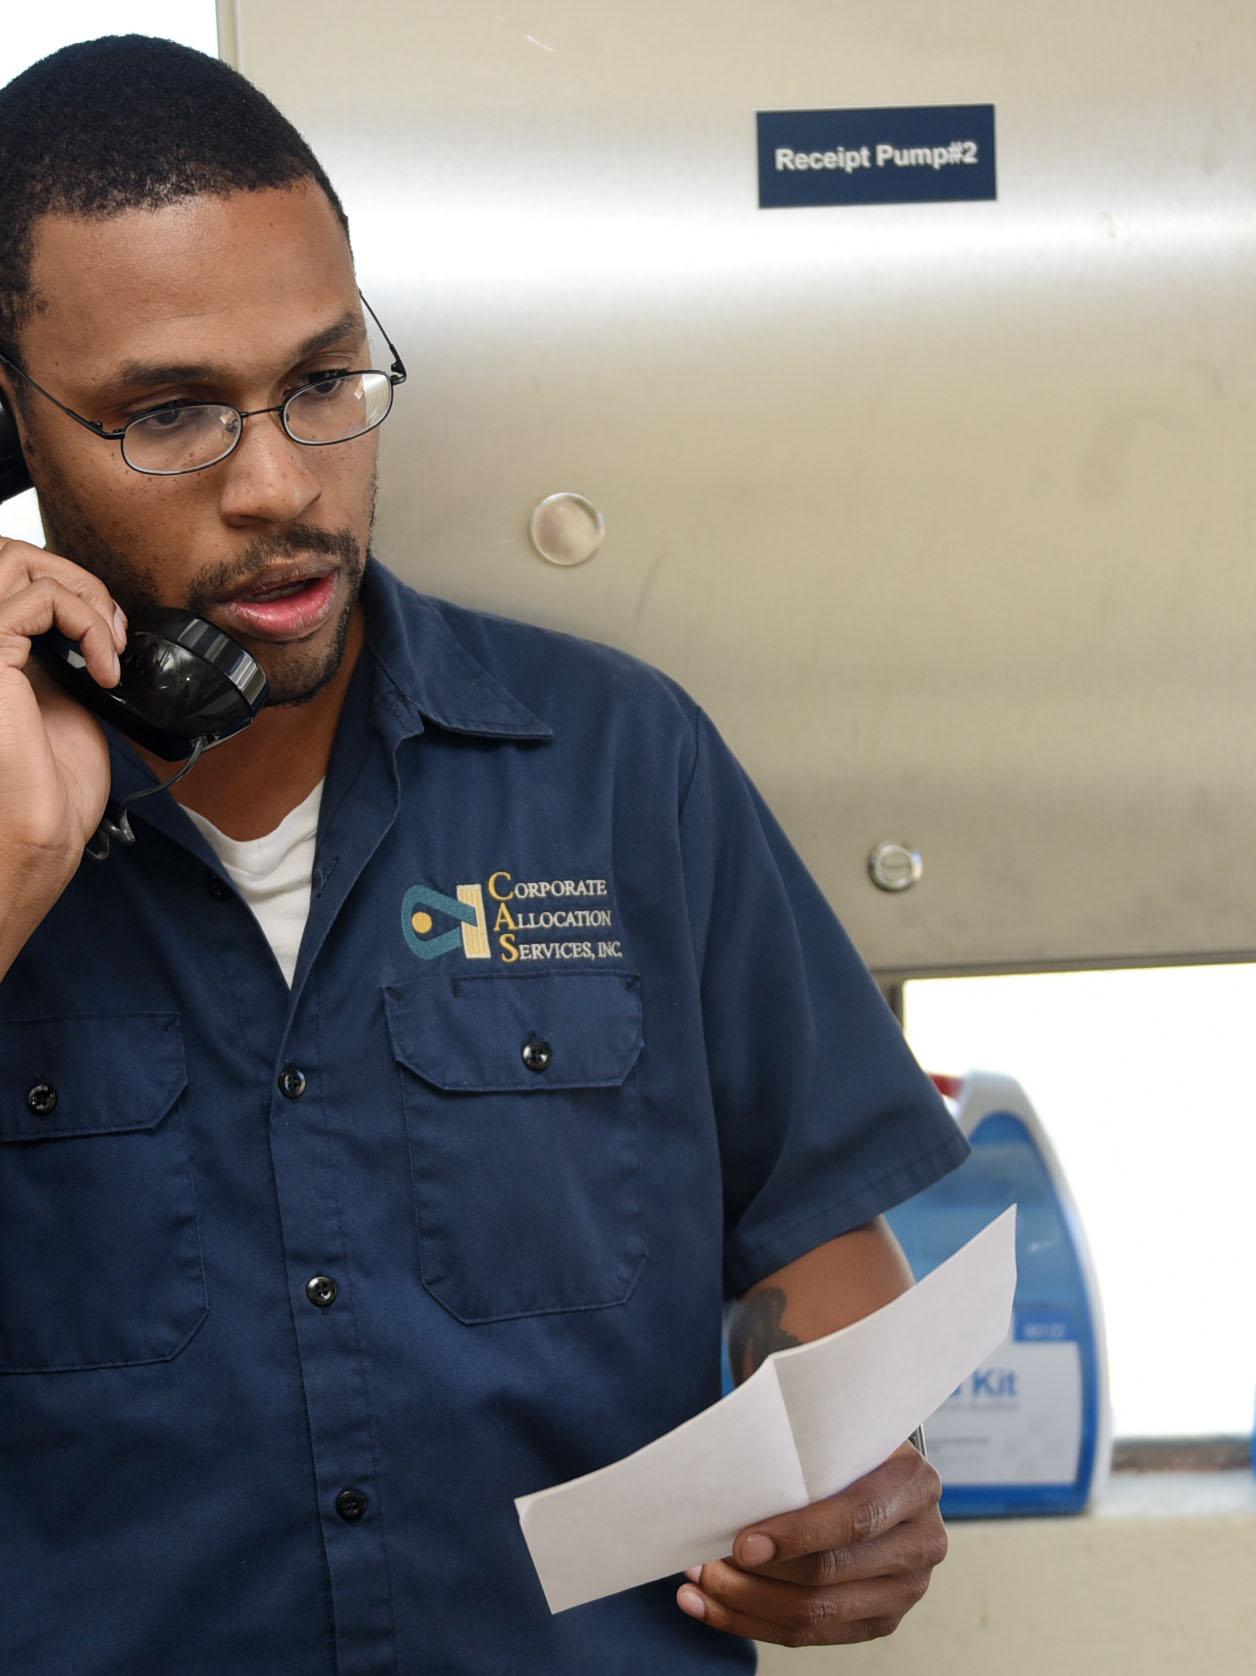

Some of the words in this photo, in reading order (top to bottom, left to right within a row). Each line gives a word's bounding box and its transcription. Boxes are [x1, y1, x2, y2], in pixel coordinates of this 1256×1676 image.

[775, 146, 870, 173] Receipt
[876, 141, 978, 170] Pump#2
[488, 871, 607, 900] CORPORATE
[494, 902, 611, 931] ALLOCATION
[499, 933, 595, 962] SERVICES,
[972, 1368, 1017, 1396] Kit
